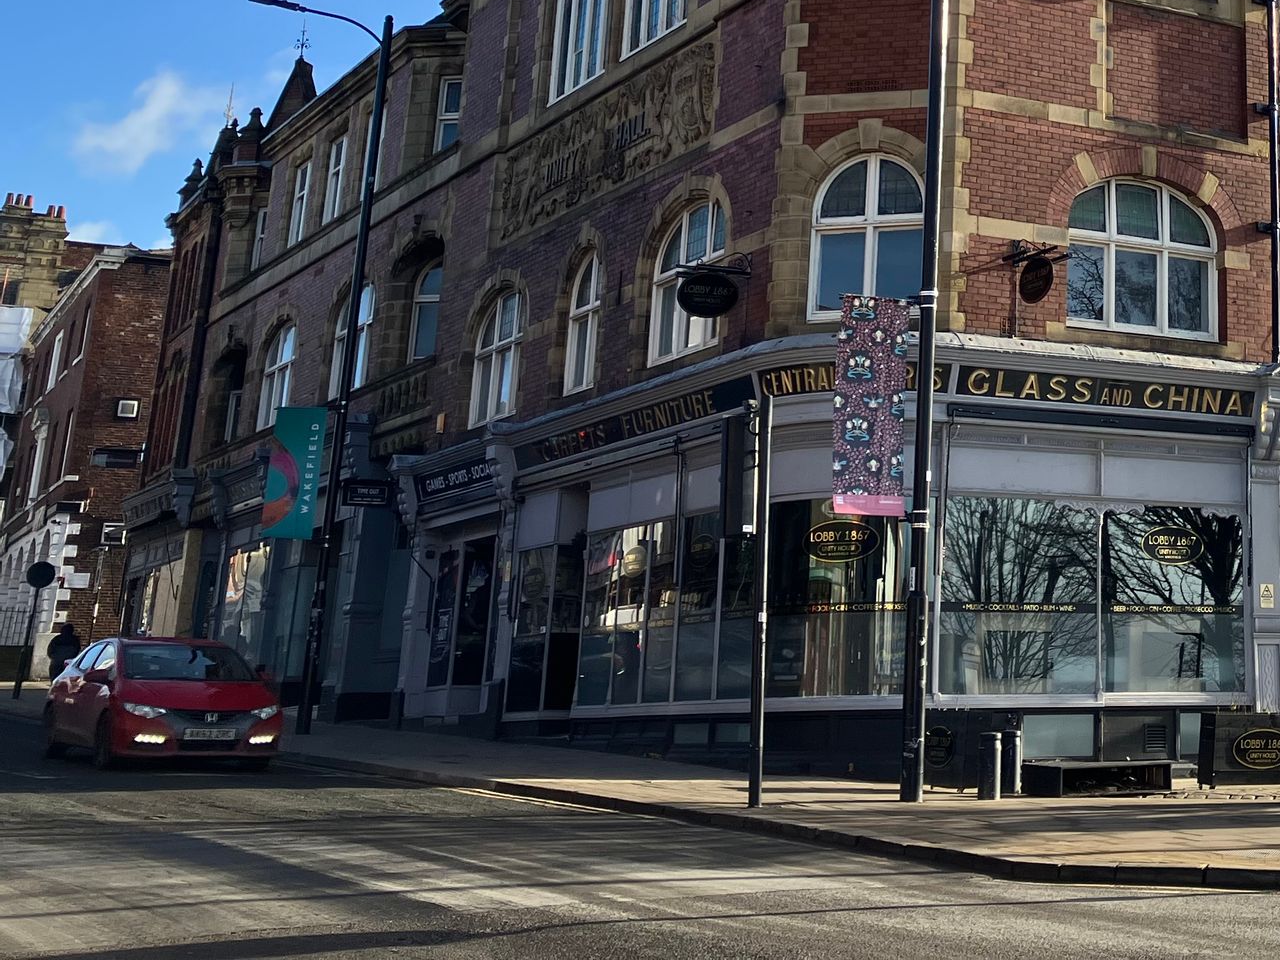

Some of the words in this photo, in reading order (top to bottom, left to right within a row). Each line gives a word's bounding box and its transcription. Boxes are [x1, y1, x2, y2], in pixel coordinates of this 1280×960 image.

[545, 147, 580, 190] UNITY
[967, 369, 1092, 403] GLASS
[1100, 388, 1132, 406] AND
[1143, 384, 1243, 416] CHINA
[621, 390, 717, 438] FURNITURE
[300, 423, 320, 514] WAKEFIELD
[426, 476, 445, 492] GAMES
[448, 469, 469, 486] SPORTS
[810, 531, 841, 542] LOBBY
[844, 530, 871, 541] 1867
[1148, 535, 1175, 545] LOBBY
[1176, 536, 1196, 546] 1867
[1240, 739, 1266, 749] LOBBY
